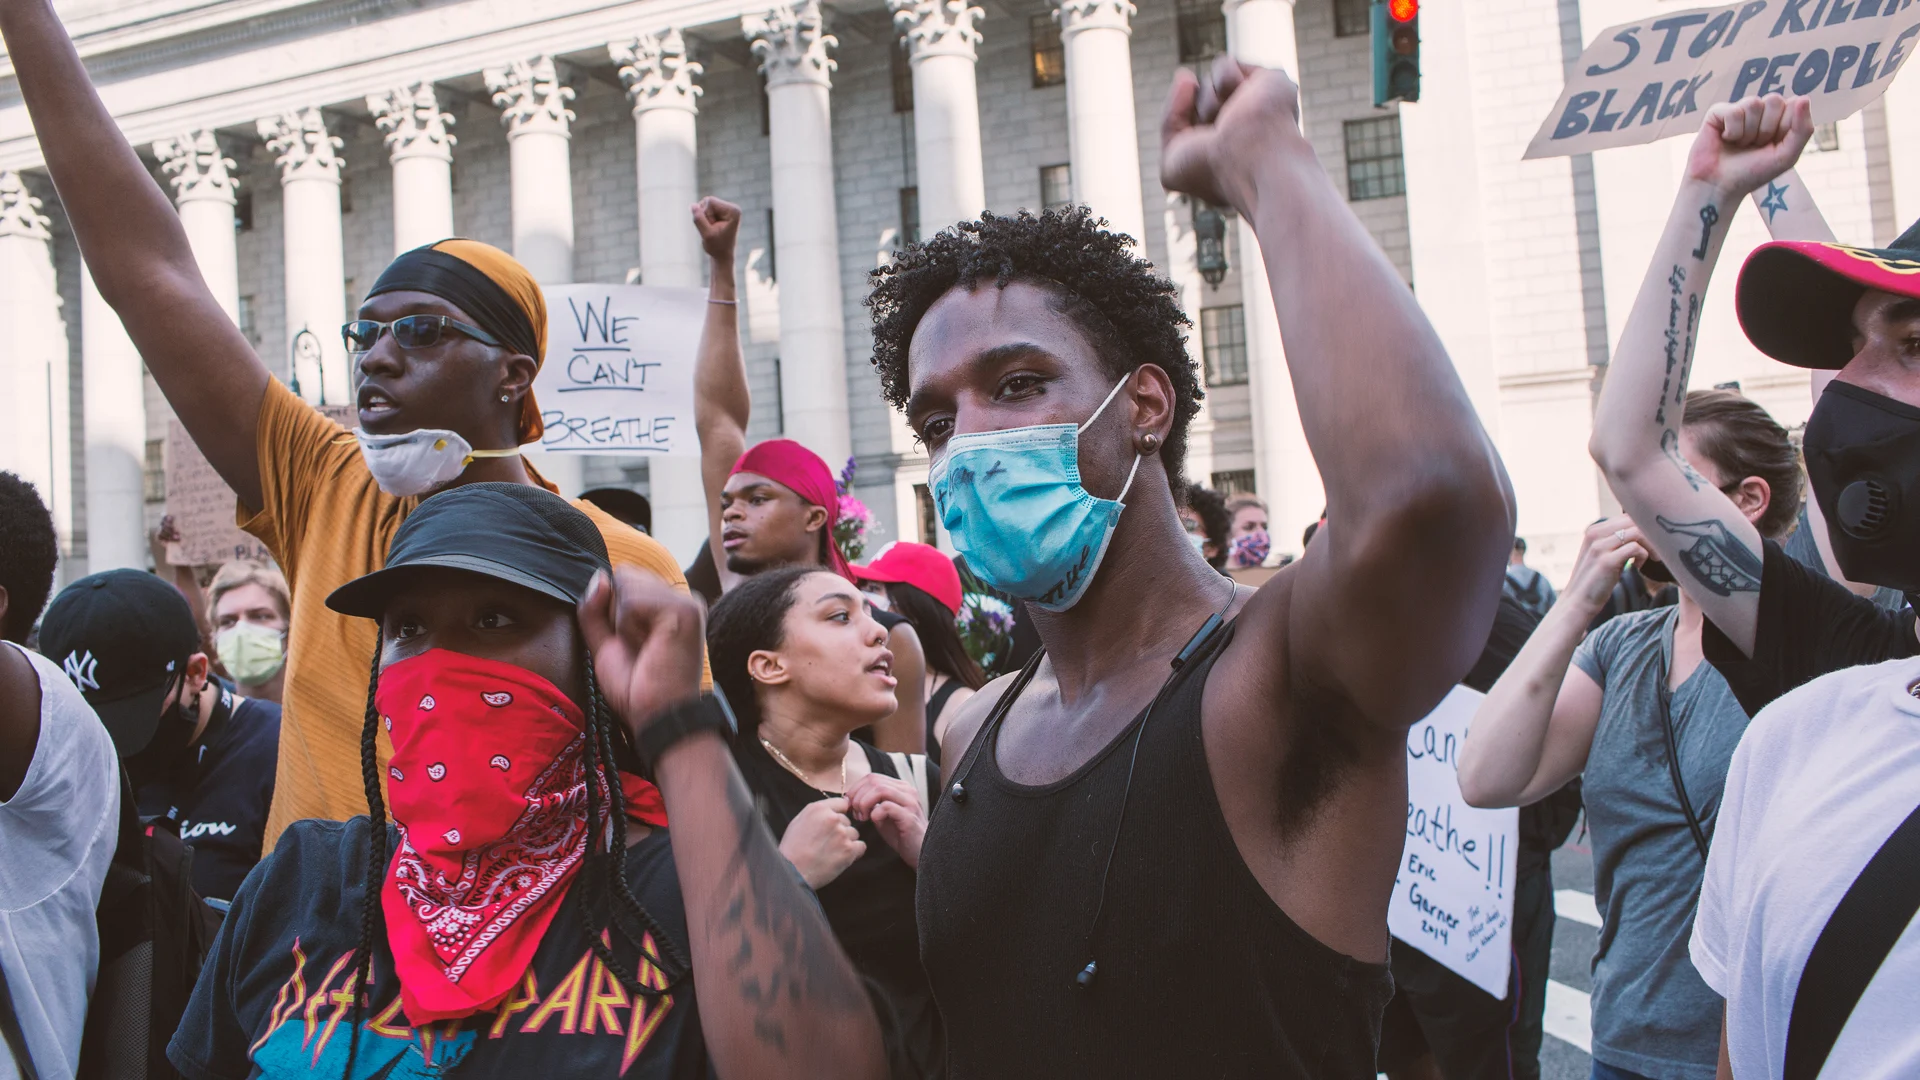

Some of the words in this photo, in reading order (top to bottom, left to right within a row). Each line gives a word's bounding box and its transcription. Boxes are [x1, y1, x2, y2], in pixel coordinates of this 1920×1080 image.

[1586, 0, 1768, 77] STOP
[1550, 70, 1713, 140] BLACK
[1728, 22, 1920, 103] PEOPLE
[568, 296, 640, 344] WE
[566, 354, 662, 385] CAN'T
[541, 410, 676, 445] BREATHE
[1408, 853, 1437, 882] Eric
[1409, 882, 1460, 930] Garner
[1421, 919, 1448, 946] 2014
